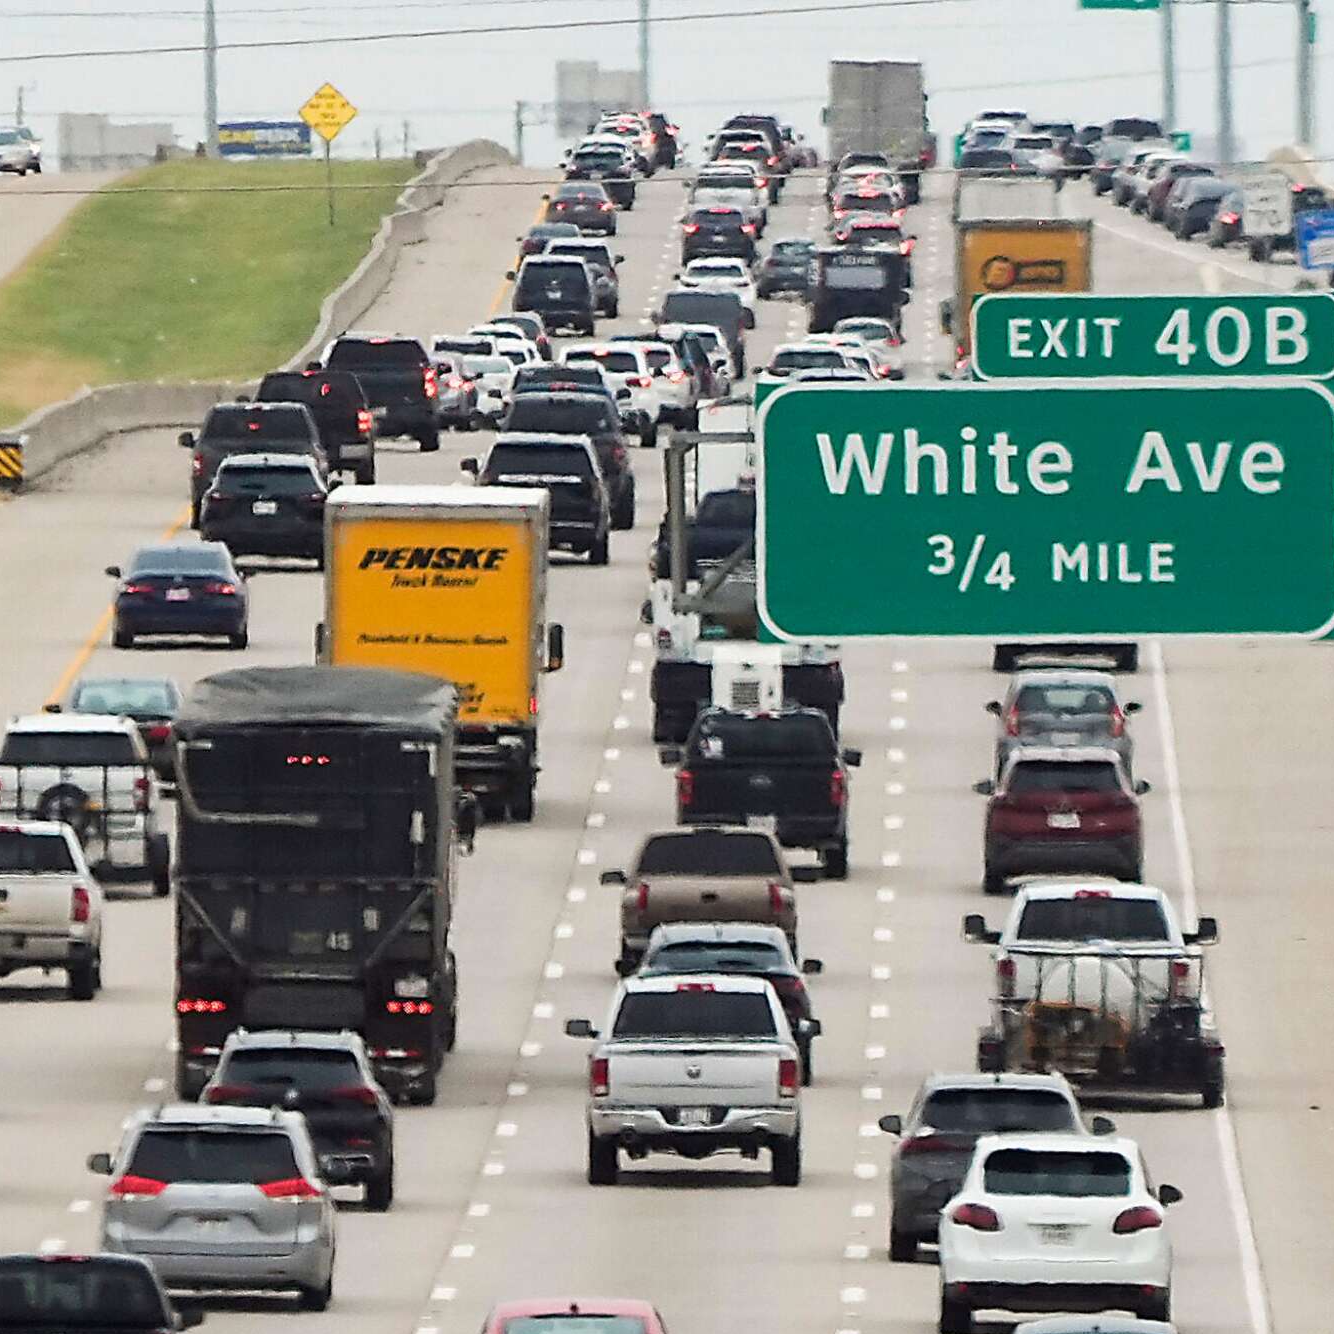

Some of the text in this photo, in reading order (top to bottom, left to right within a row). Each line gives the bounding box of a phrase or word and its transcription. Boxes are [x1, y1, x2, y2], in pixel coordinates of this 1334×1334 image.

[1007, 306, 1311, 367] EXIT 40B
[816, 426, 1286, 495] White Ave
[358, 547, 510, 570] PENSKE
[926, 534, 1177, 592] 3/4 MILE
